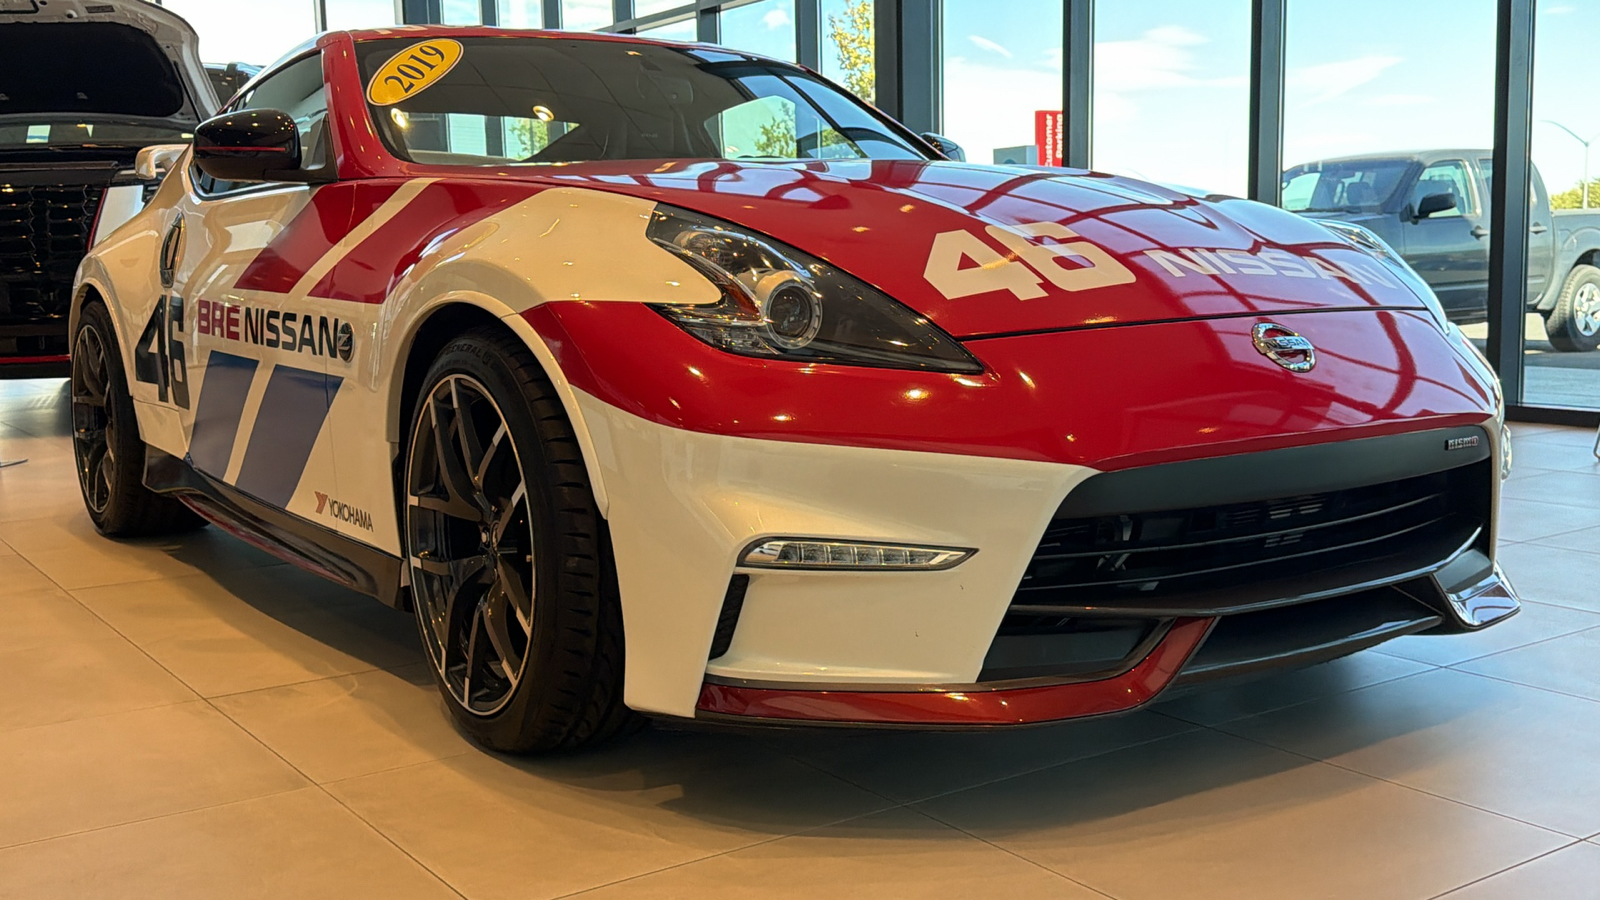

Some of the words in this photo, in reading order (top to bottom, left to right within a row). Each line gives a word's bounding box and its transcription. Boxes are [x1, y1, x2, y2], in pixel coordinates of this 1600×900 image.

[384, 45, 445, 93] 2019
[1055, 113, 1063, 158] Parking
[923, 221, 1137, 301] 46
[1143, 247, 1398, 290] NISSAN
[134, 295, 190, 410] 46
[197, 300, 241, 341] BRE
[244, 307, 339, 359] NISSAN
[328, 498, 374, 533] YOKOHAMA
